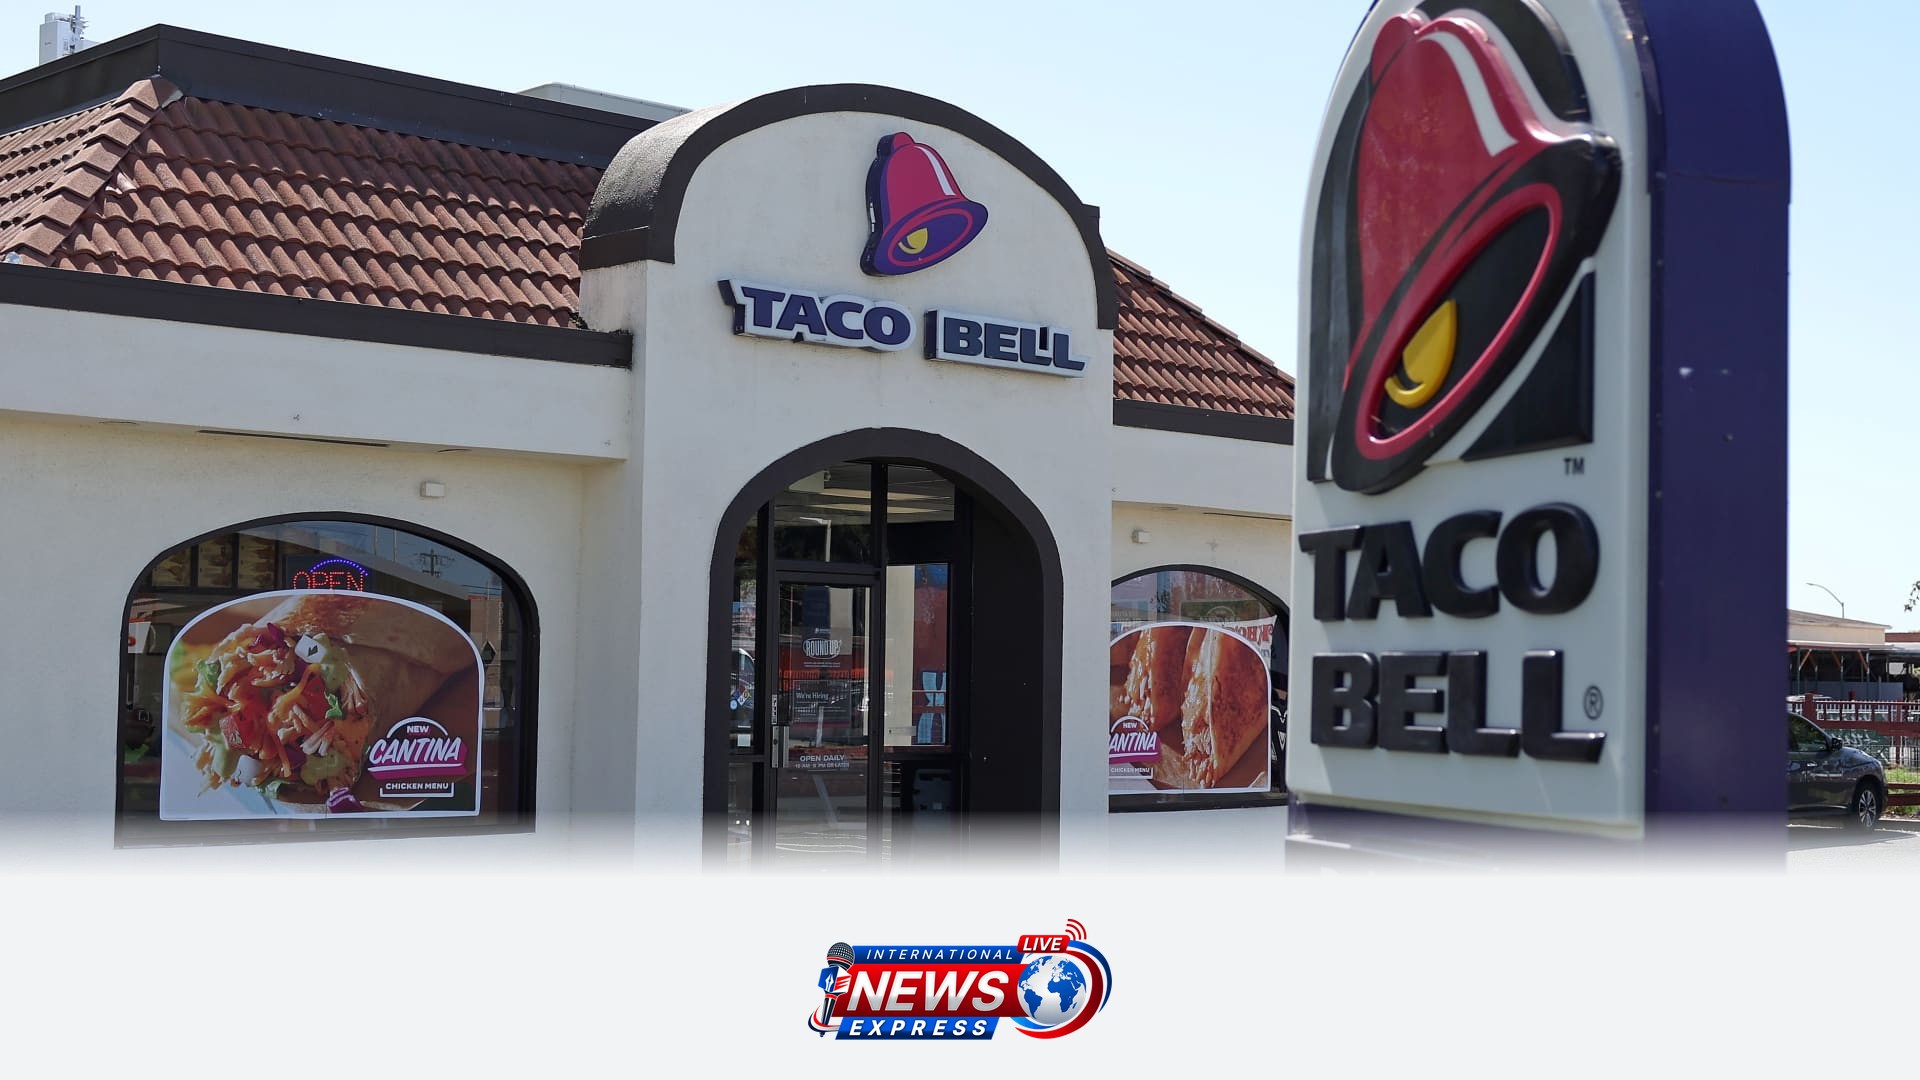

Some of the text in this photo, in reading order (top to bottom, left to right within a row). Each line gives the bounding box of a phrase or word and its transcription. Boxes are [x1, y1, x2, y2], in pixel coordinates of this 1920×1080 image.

[741, 286, 1085, 371] TACO BELL
[1298, 502, 1600, 622] TACO
[293, 571, 364, 592] OPEN
[1310, 650, 1607, 763] BELL
[406, 725, 430, 734] NEW
[1109, 731, 1158, 753] ANTINA
[369, 736, 463, 765] CANTINA
[385, 782, 449, 790] CHICKEN MENU
